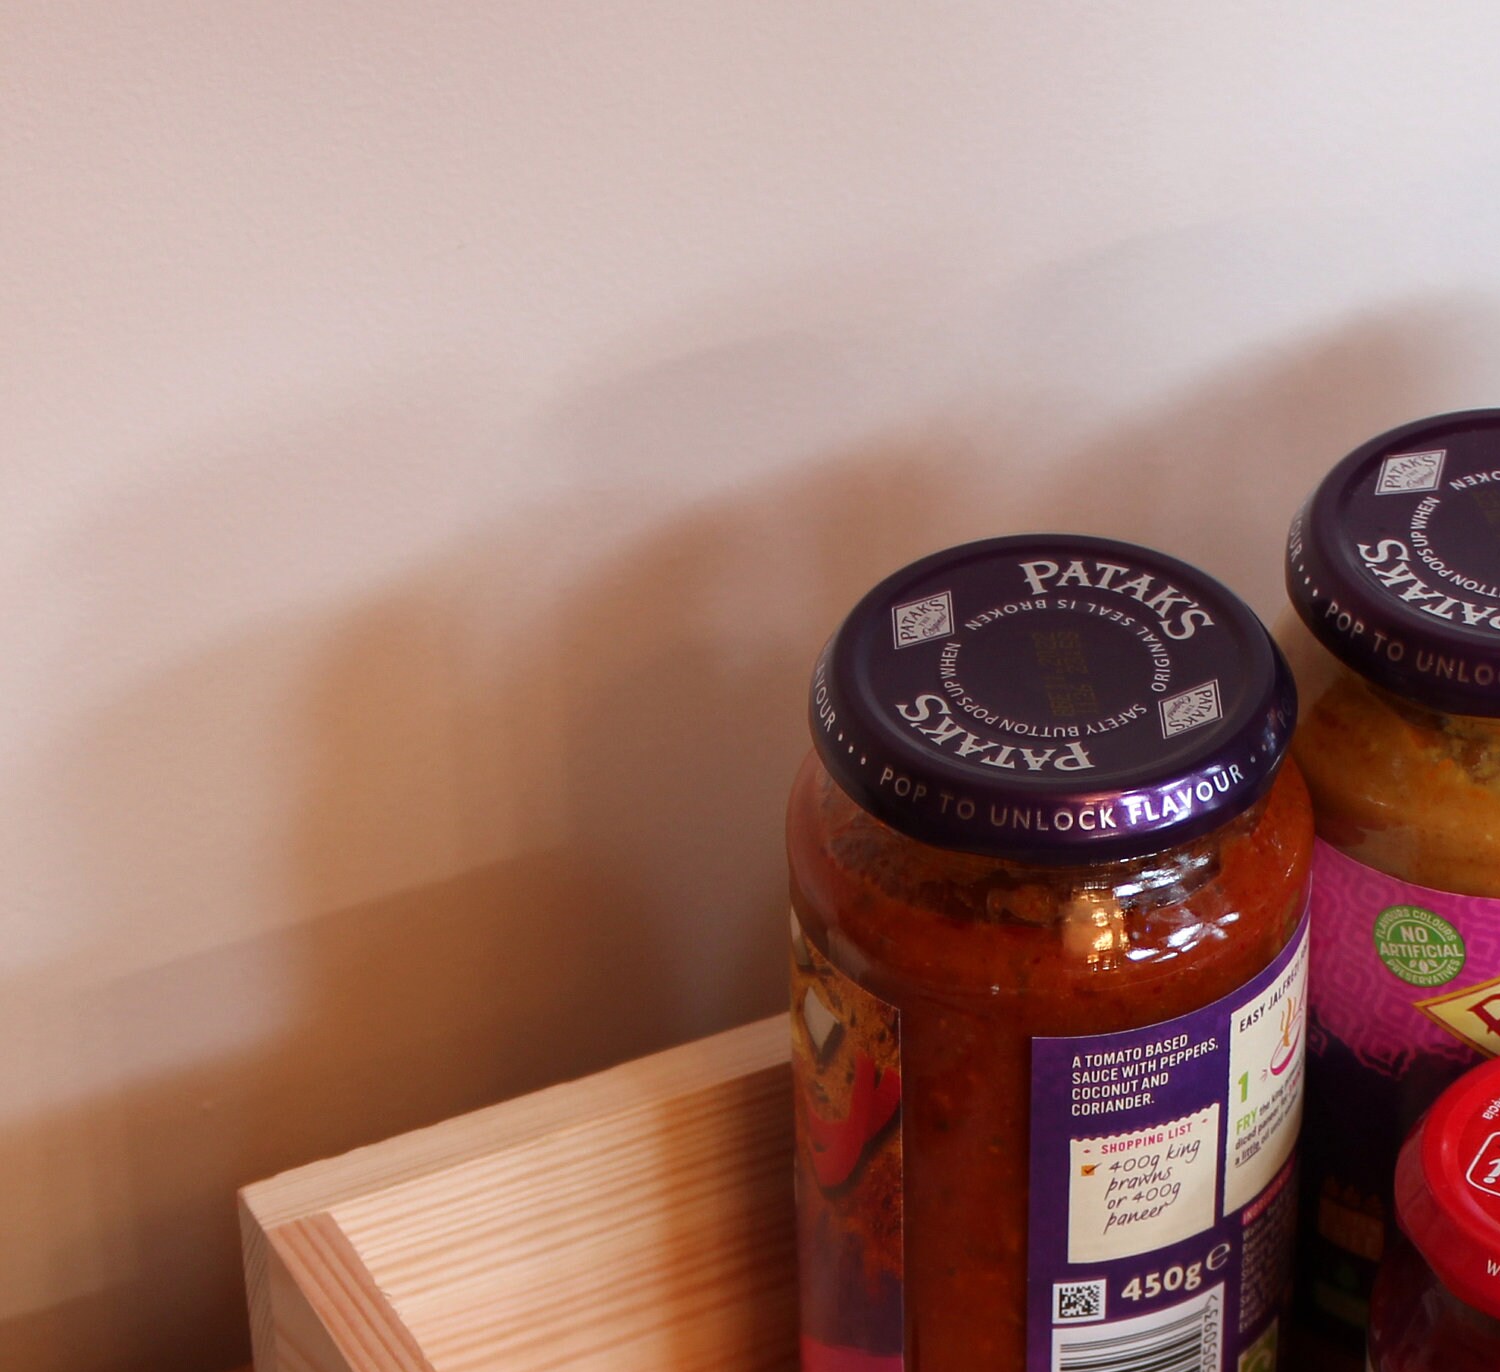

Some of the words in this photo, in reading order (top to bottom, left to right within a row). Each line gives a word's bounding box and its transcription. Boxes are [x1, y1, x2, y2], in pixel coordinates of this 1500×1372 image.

[1384, 454, 1436, 489] PATAK'S
[1410, 496, 1440, 530] WHEN
[1411, 531, 1428, 547] UP
[1417, 548, 1450, 578] POPS
[964, 599, 1047, 631] BROKEN
[1019, 561, 1215, 640] PATAK'S
[1058, 599, 1076, 609] IS
[1088, 602, 1135, 626] SEAL
[901, 599, 945, 642] PATAK'S
[1325, 600, 1364, 638] POP
[1374, 632, 1404, 661] TO
[940, 642, 961, 679] WHEN
[1137, 626, 1171, 692] ORIGINAL
[944, 681, 963, 697] UP
[957, 696, 999, 724] POPS
[1086, 703, 1147, 735] SAFETY
[1168, 689, 1213, 731] PATAK'S
[895, 694, 1096, 771] PATAK'S
[998, 719, 1079, 738] BUTTON
[880, 768, 927, 802] POP
[940, 793, 975, 820] TO
[991, 805, 1117, 831] UNLOCK
[1130, 764, 1244, 824] FLAVOUR
[1400, 926, 1428, 943] NO
[1412, 910, 1457, 942] COLOURS
[1380, 942, 1465, 958] ARTIFICIAL
[1386, 959, 1460, 985] PRESERVATIVES
[1239, 1003, 1266, 1033] EASY
[1072, 1056, 1081, 1068] A
[1085, 1047, 1142, 1068] TOMATO
[1145, 1034, 1188, 1057] BASED
[1072, 1068, 1119, 1085] SAUCE
[1121, 1060, 1156, 1079] WITH
[1160, 1038, 1219, 1069] PEPPERS.
[1072, 1080, 1139, 1101] COCONUT
[1141, 1072, 1169, 1090] AND
[1238, 1071, 1249, 1103] 1
[1071, 1093, 1155, 1116] CORIANDER.
[1236, 1107, 1258, 1136] FRY
[1101, 1133, 1164, 1154] SHOPPING
[1168, 1122, 1192, 1139] LIST
[1109, 1154, 1160, 1175] 400g
[1166, 1139, 1201, 1164] king
[1104, 1166, 1173, 1201] prawns
[1107, 1196, 1127, 1210] or
[1132, 1182, 1181, 1207] 400g
[1103, 1202, 1170, 1235] paneer
[1121, 1261, 1202, 1301] 450g
